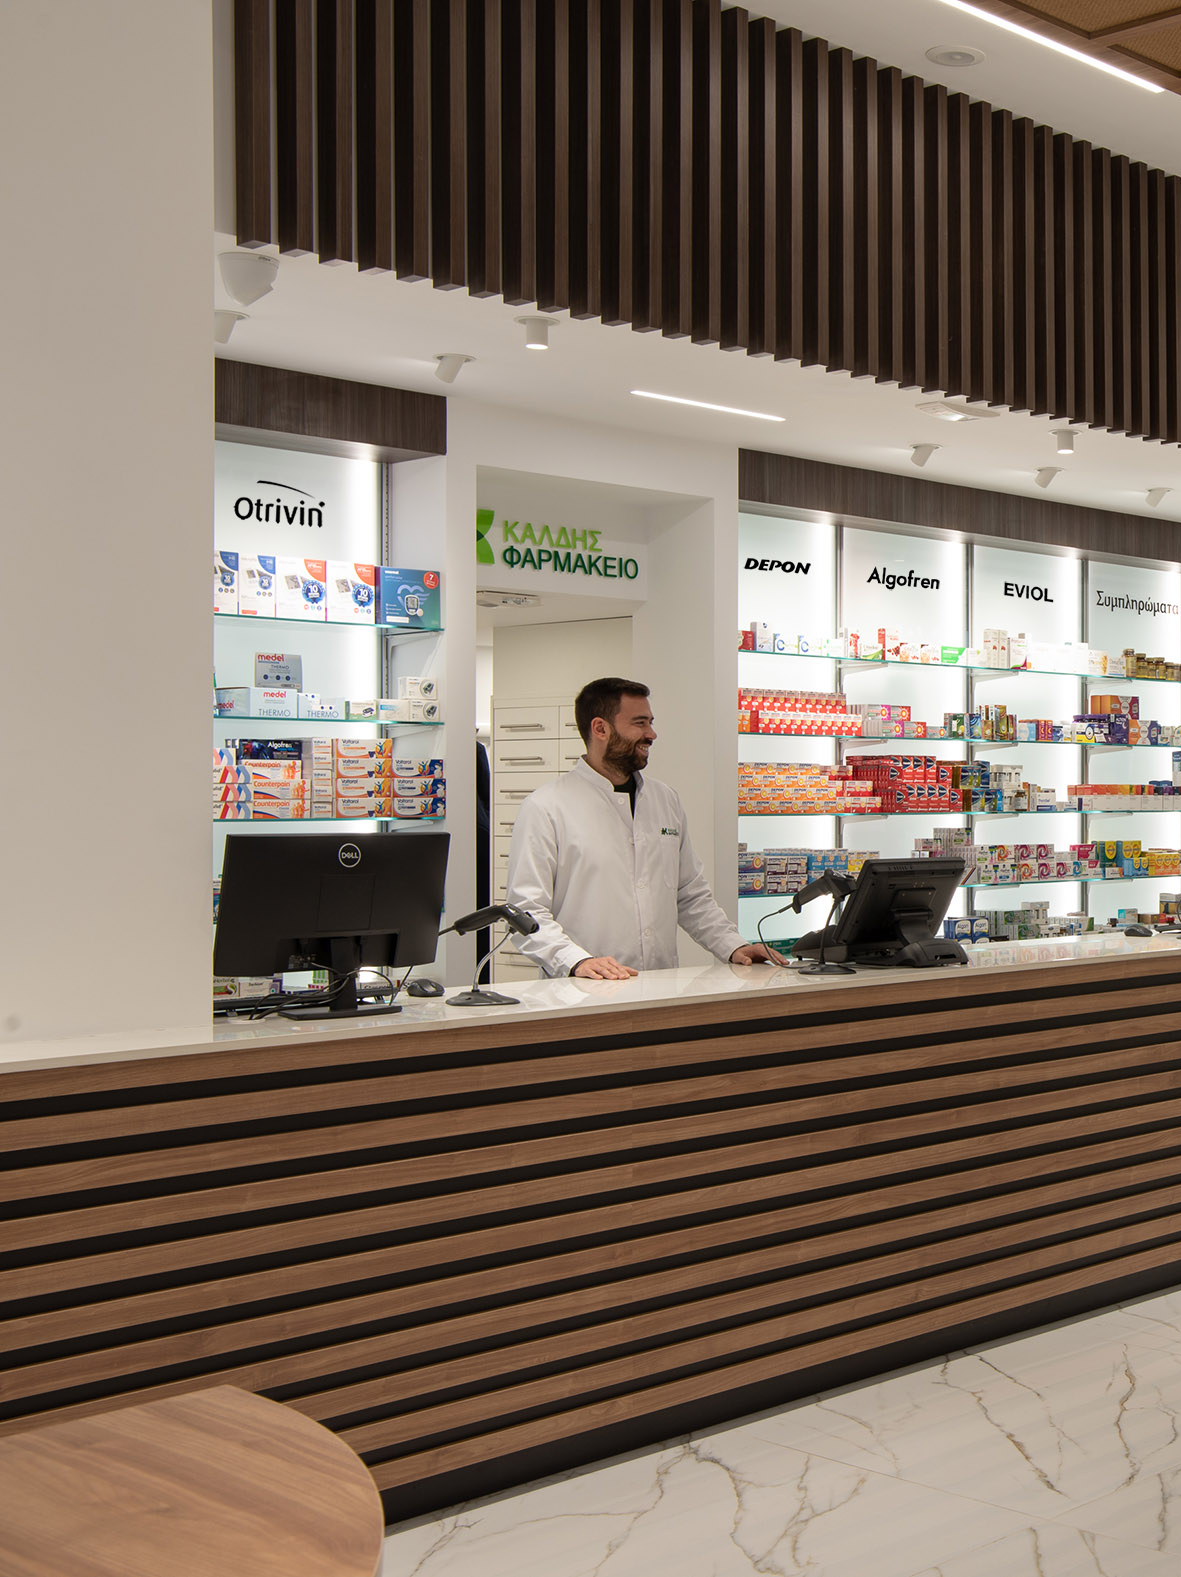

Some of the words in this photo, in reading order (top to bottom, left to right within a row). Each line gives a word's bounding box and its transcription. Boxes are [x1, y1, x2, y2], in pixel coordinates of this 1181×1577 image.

[234, 497, 325, 528] Otrivin
[503, 520, 602, 552] ΚΑΛΔΗΣ
[503, 545, 639, 579] ΦΑΡΜΑΚΕΙΟ
[744, 557, 812, 575] DEPON
[866, 566, 940, 590] Algofren
[1004, 581, 1054, 603] EVIOL
[1096, 590, 1179, 617] Συμπληρώματα
[257, 653, 285, 662] medel
[258, 708, 291, 717] THERMO
[307, 710, 339, 719] THERMO
